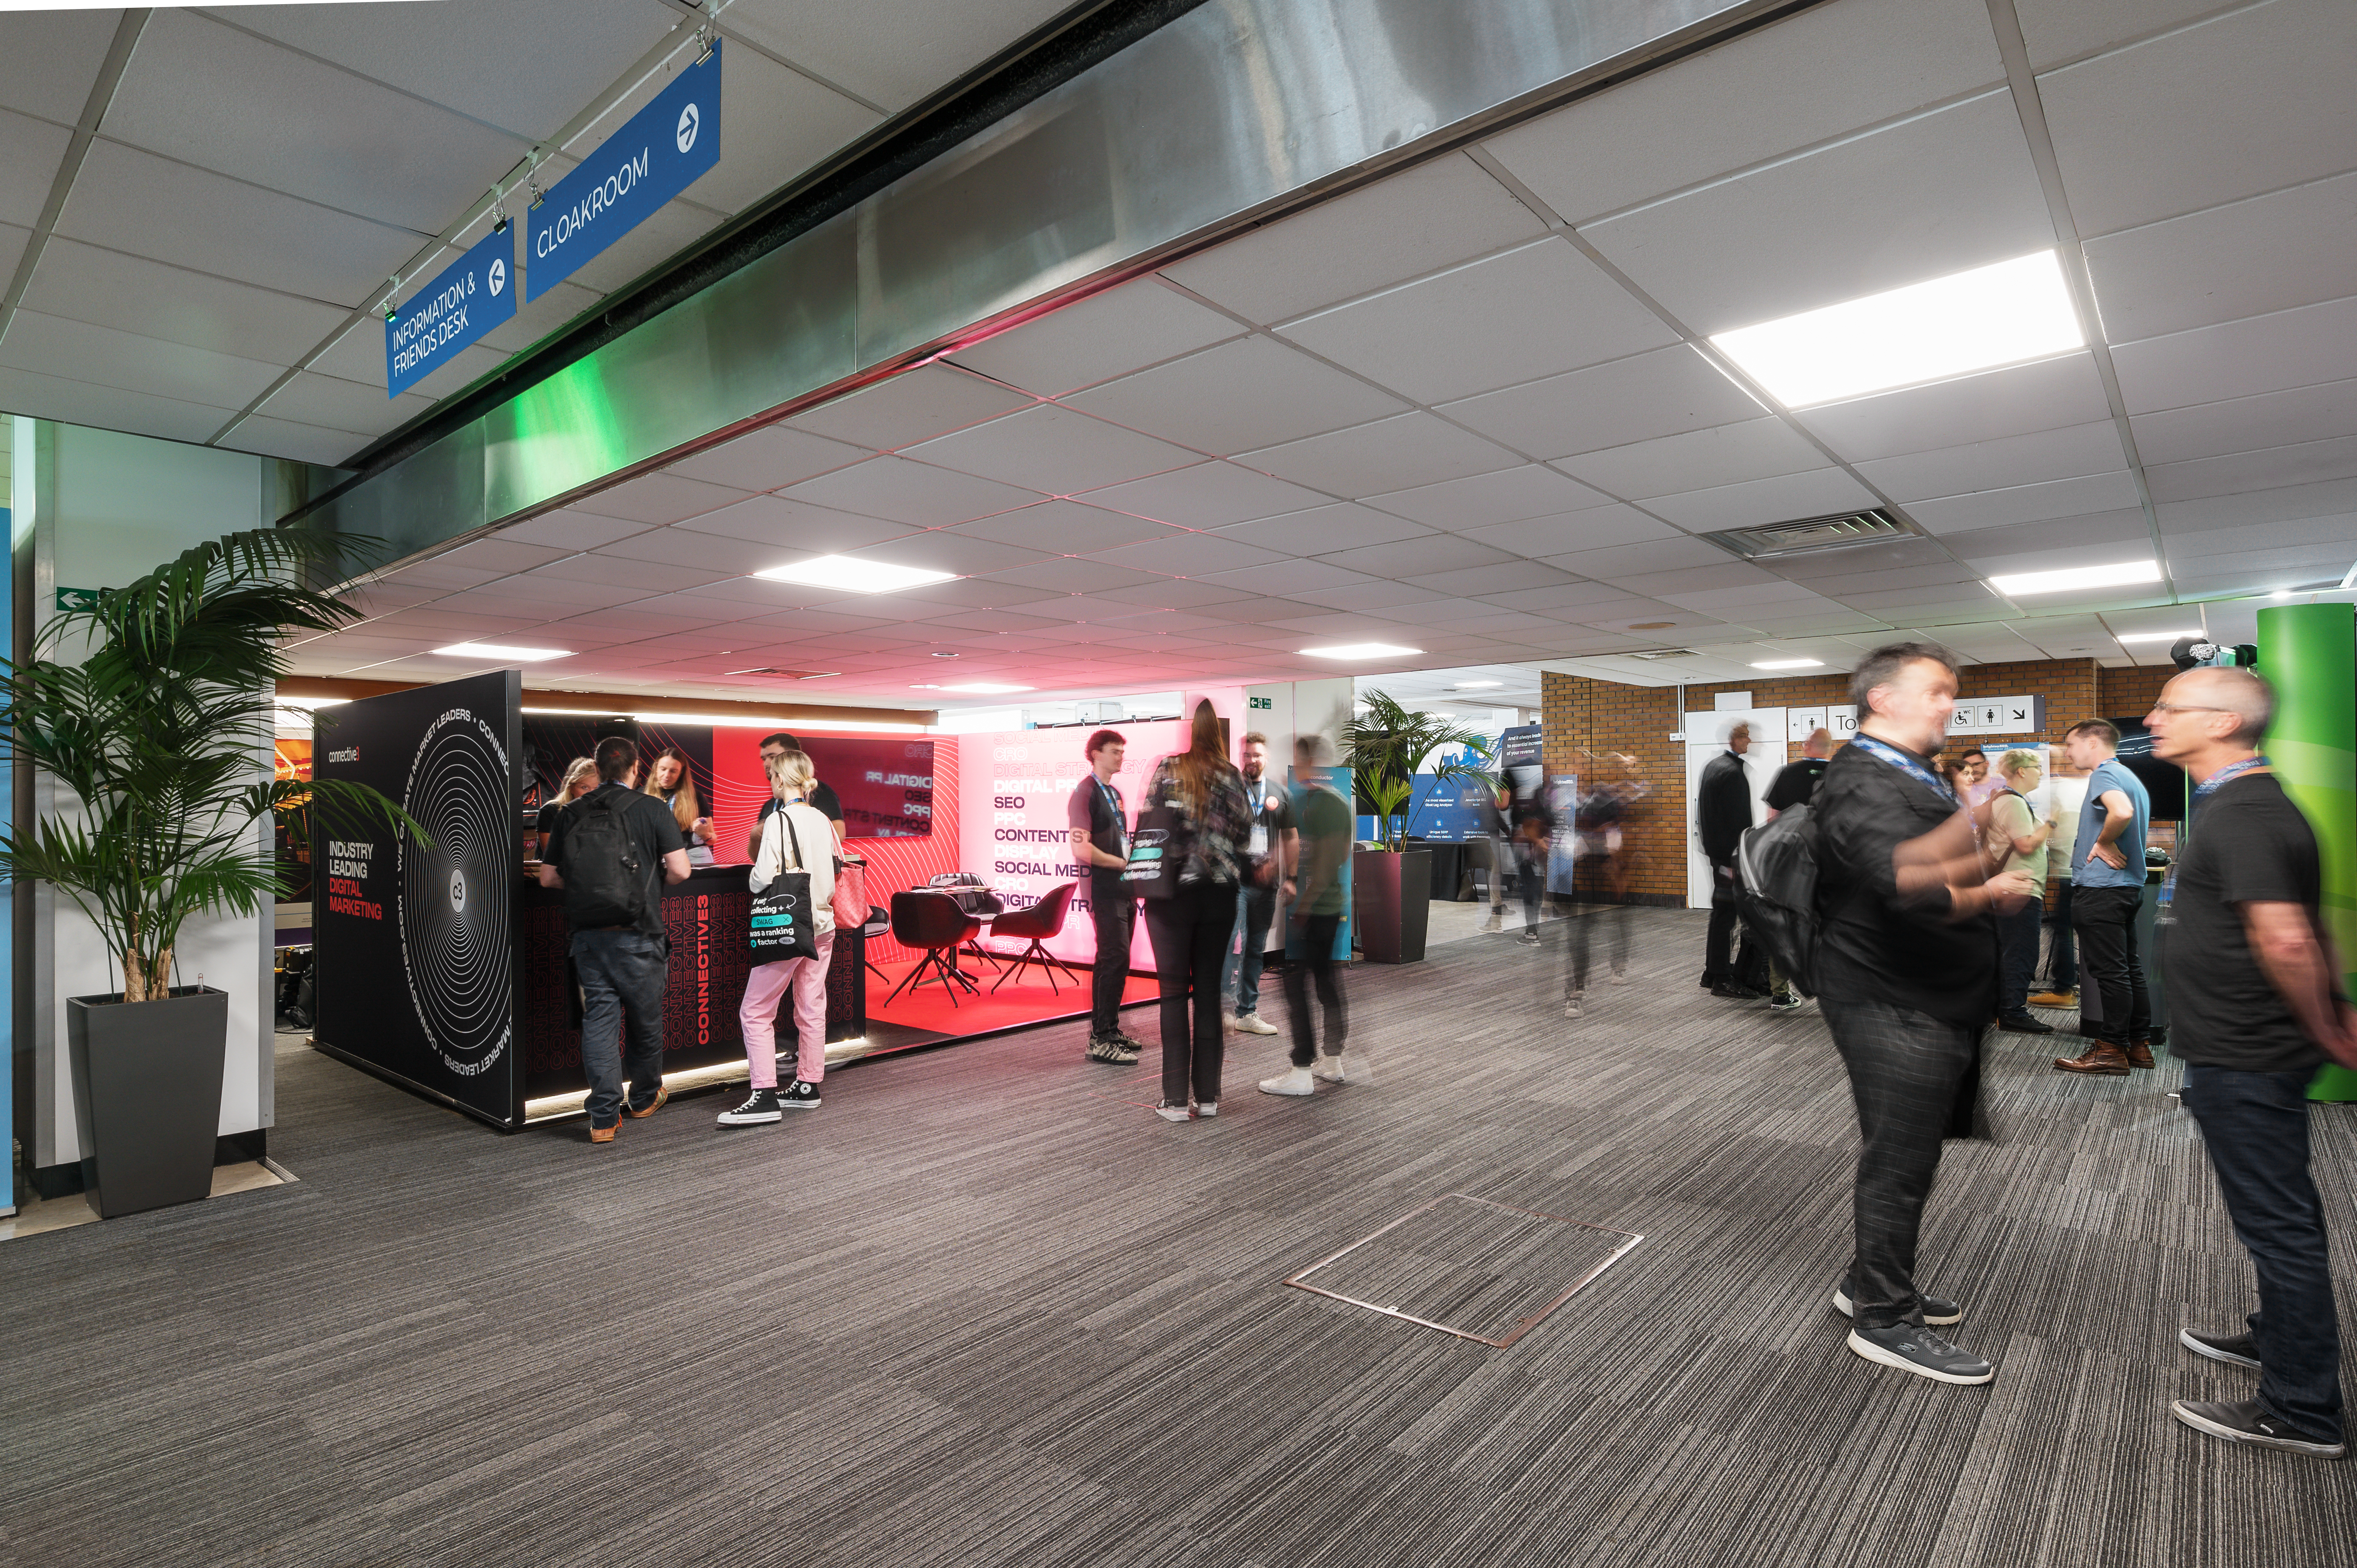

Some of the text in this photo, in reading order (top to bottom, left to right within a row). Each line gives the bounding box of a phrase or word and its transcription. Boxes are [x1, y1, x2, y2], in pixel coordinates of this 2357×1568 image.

[537, 146, 649, 258] CLOAKROOM
[393, 271, 476, 352] INFORMATION &
[394, 304, 469, 377] FRIENDS DESK
[1835, 715, 1857, 730] To
[412, 722, 436, 775] MARKET
[437, 708, 471, 729] LEADERS
[993, 726, 1105, 745] SOCIAL MED
[329, 746, 360, 763] connective3
[993, 747, 1028, 761] CRO
[994, 759, 1146, 777] DIGITAL STRGY
[994, 779, 1078, 793] DIGITAL PR
[994, 796, 1025, 809] SEO
[994, 812, 1026, 826] PPC
[995, 829, 1069, 843] CONTENT
[329, 841, 373, 860] INDUSTRY
[995, 844, 1059, 860] DISPLAY
[329, 859, 368, 879] LEADING
[995, 861, 1092, 878] SOCIAL MED
[329, 878, 362, 897] DIGITAL
[453, 881, 463, 901] c3
[995, 877, 1029, 892] CRO
[329, 896, 382, 920] MARKETING
[995, 893, 1042, 907] DIGITA
[751, 905, 777, 915] collecting
[766, 927, 794, 935] ranking
[398, 842, 437, 1050] CONNECTIVE3.COM WE
[669, 896, 682, 1049] CONNECTIVE3
[683, 895, 696, 1047] CONNECTIVE3
[698, 895, 709, 1045] CONNECTIVE3
[710, 893, 722, 1043] CONNECTIVE3
[723, 893, 735, 1040] CONNECTIVE3
[736, 892, 748, 1038] NECTIVE3
[843, 929, 853, 1020] CONNECT
[534, 906, 548, 1072] CONNECTIVE3
[444, 1025, 511, 1076] MARKET LEADERS
